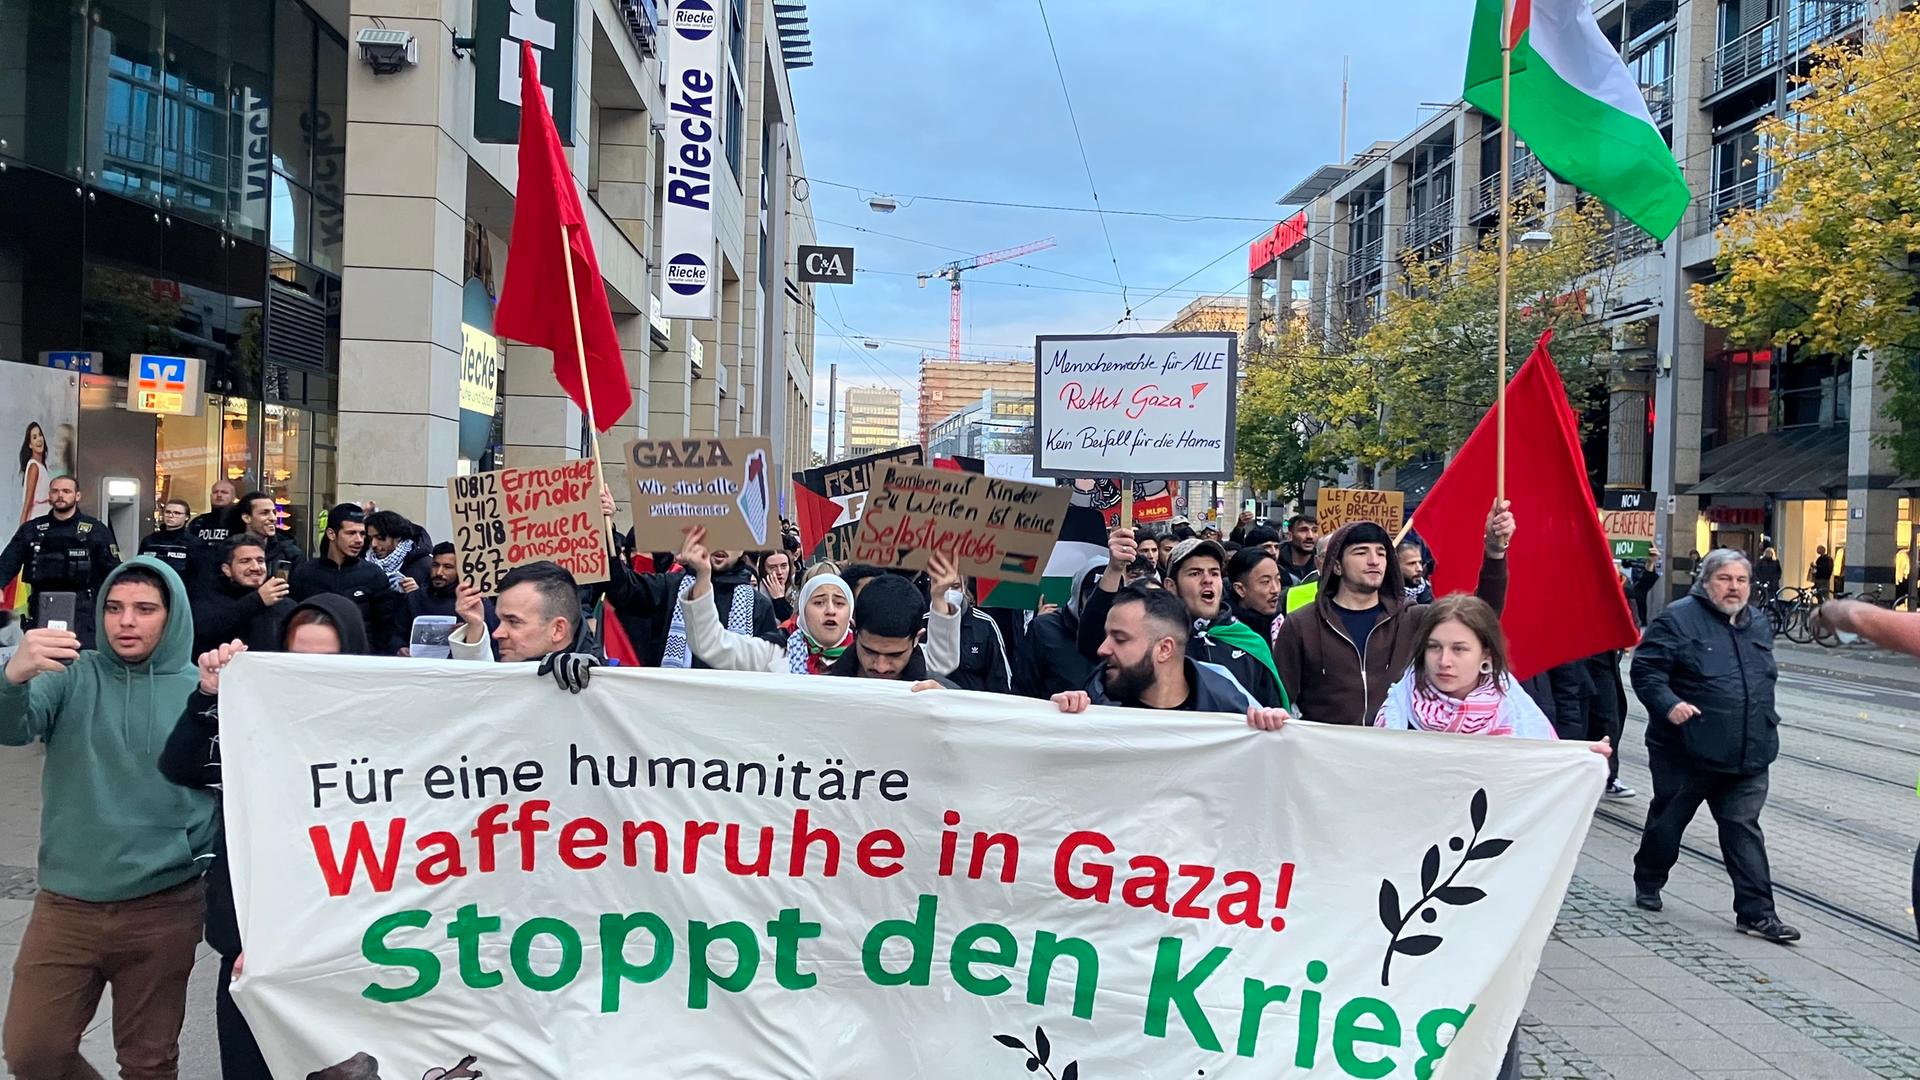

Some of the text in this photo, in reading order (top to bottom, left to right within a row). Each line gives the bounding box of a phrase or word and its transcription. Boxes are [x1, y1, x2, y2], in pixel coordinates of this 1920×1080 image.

[676, 11, 713, 24] Riecke
[668, 68, 714, 211] Riecke
[668, 265, 706, 279] Riecke
[805, 252, 846, 276] C&A
[1160, 351, 1182, 376] für
[1181, 352, 1226, 371] ALLE
[1059, 382, 1124, 411] Rettet
[1046, 426, 1222, 457] Kein Beifall für die Hamas
[633, 441, 733, 468] GAZA
[455, 461, 595, 499] 10812 Ermordet
[637, 478, 738, 496] Wir sind alle
[883, 467, 1042, 504] Bomben auf Kinder
[1327, 490, 1387, 504] LET GAZA
[1621, 494, 1641, 508] NOW
[455, 498, 500, 522] 4412
[1145, 506, 1168, 516] MLPD
[1346, 503, 1399, 518] BREATHE
[508, 511, 592, 542] Frauen
[1320, 516, 1341, 535] EAT
[1603, 512, 1655, 537] CEASEFIRE
[1615, 542, 1634, 555] NOW
[462, 549, 504, 574] 667
[310, 743, 910, 809] Für eine humanitäre
[308, 800, 1296, 932] Waffenruhe in Gaza!
[361, 902, 823, 1013] Stoppt
[861, 894, 1099, 1020] den
